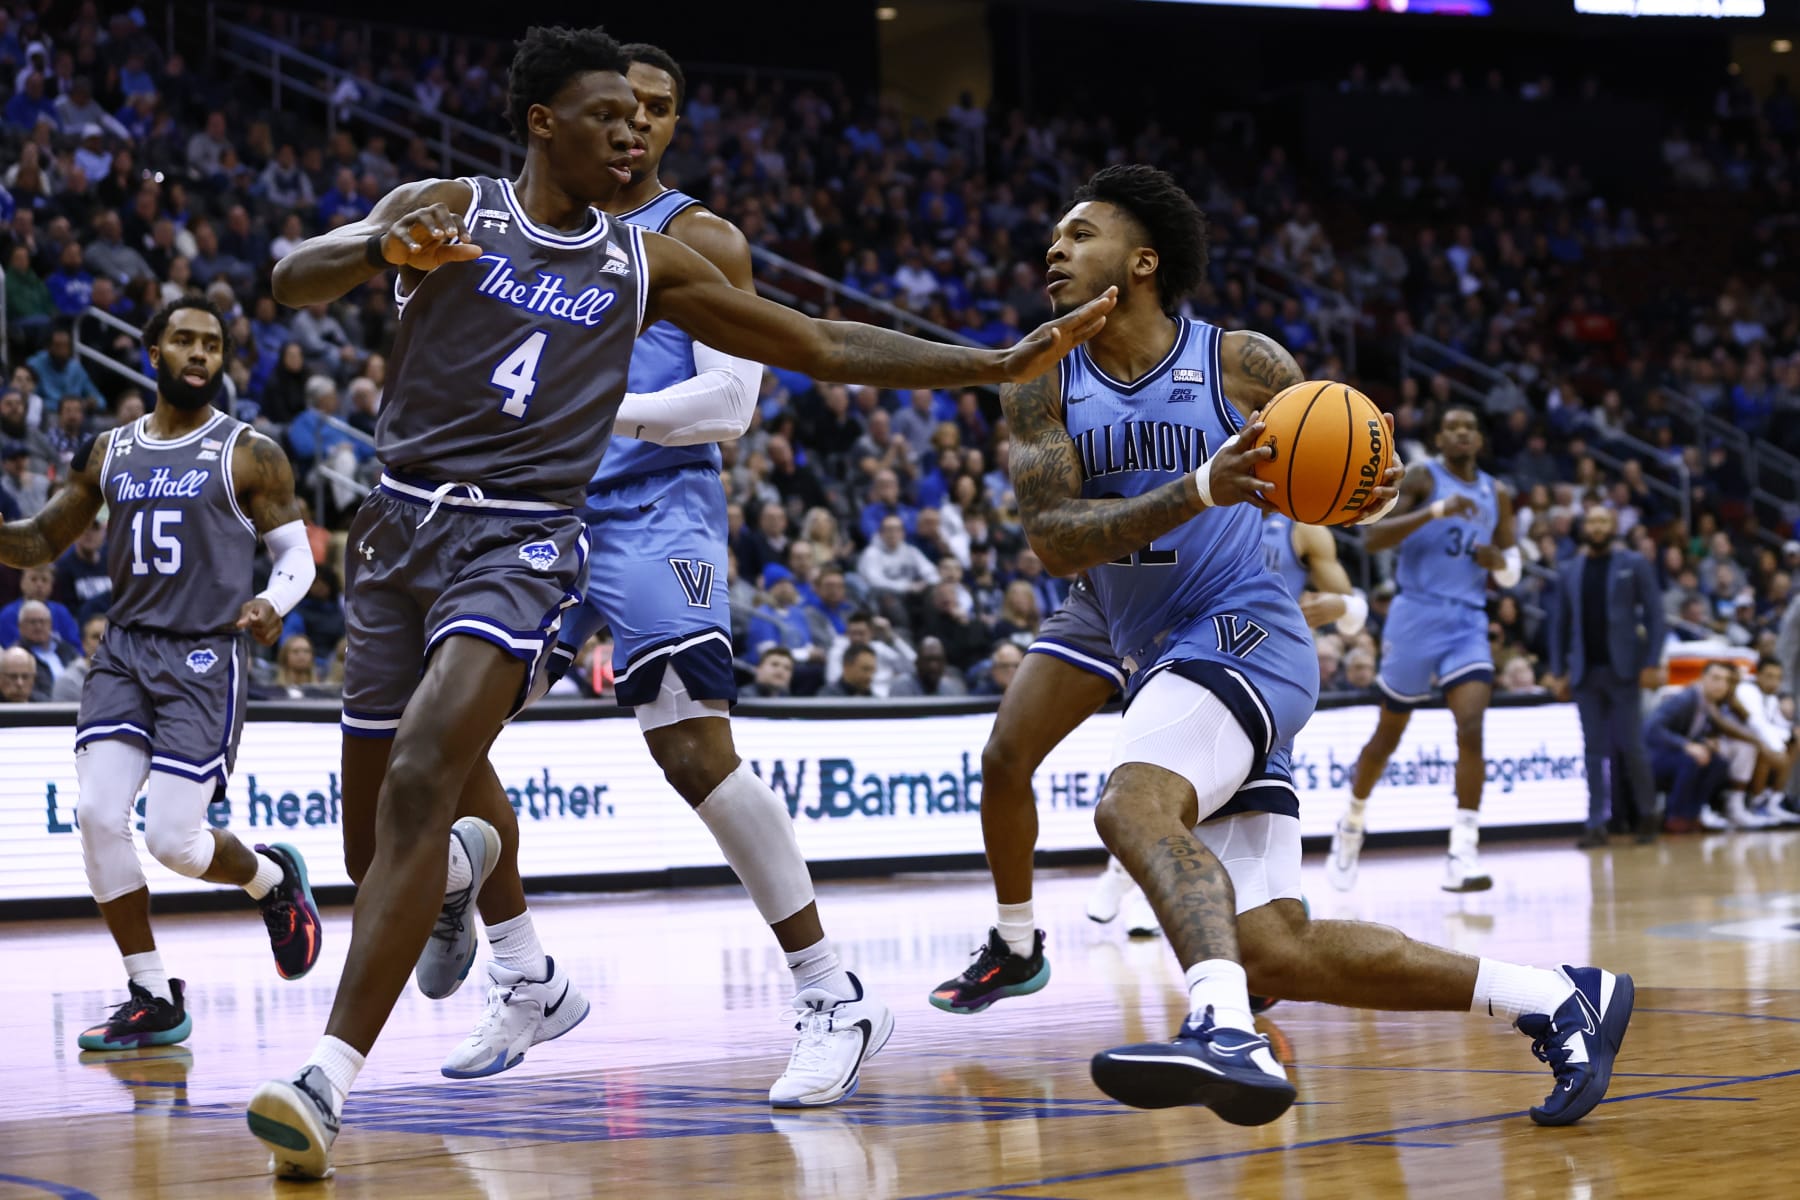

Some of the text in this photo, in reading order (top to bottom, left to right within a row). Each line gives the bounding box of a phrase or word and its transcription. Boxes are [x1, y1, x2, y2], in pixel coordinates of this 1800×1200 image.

[476, 253, 616, 327] The Hall
[490, 330, 549, 420] 4
[113, 467, 209, 502] The Hall
[1073, 420, 1210, 482] ILLANOVA
[1341, 420, 1383, 512] Wilson
[131, 509, 183, 576] 15
[248, 772, 342, 827] heal
[504, 767, 615, 821] ether.
[750, 751, 983, 820] WJBarnab
[1485, 742, 1588, 793] ogether.
